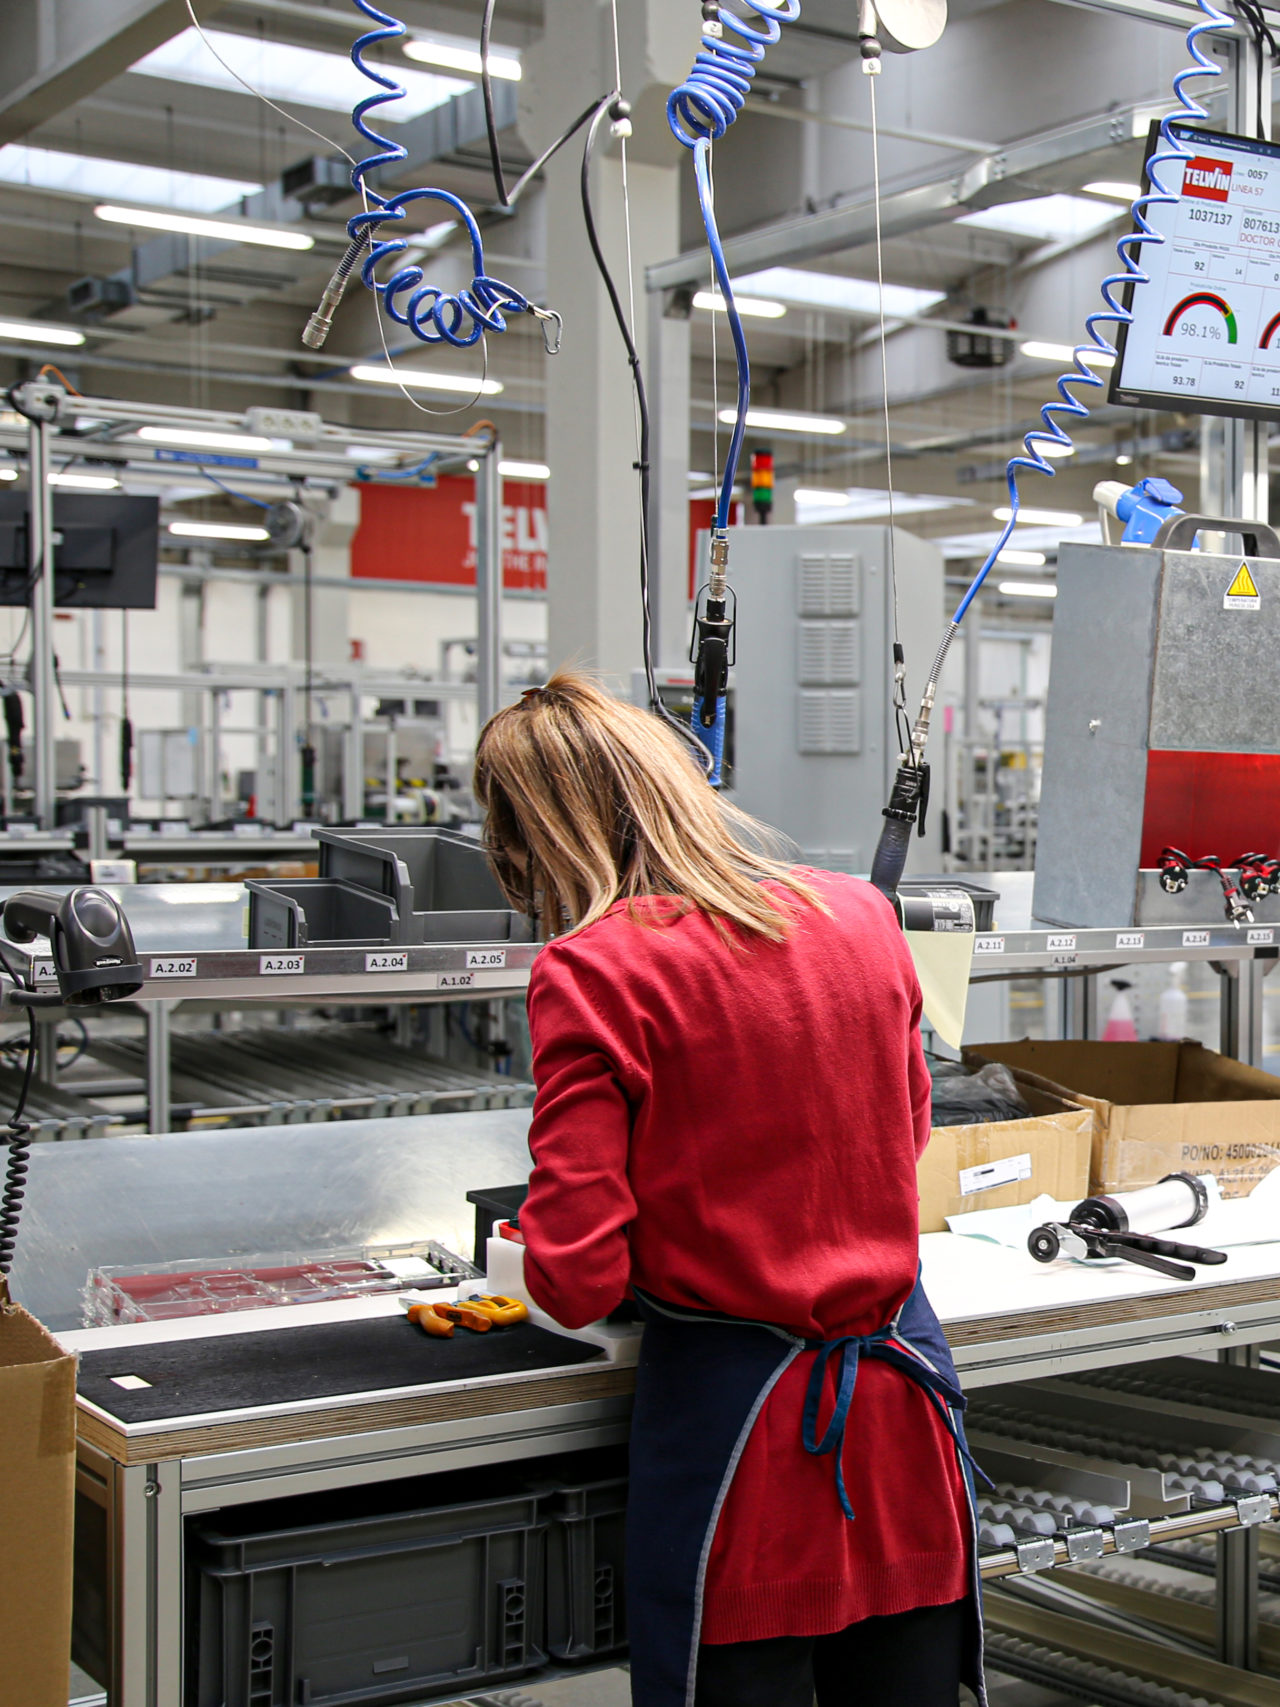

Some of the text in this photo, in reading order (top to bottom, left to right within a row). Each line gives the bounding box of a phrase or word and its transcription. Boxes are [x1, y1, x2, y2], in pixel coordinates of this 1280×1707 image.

[1185, 167, 1231, 191] TELWIN
[1248, 169, 1268, 181] 0057
[1231, 183, 1264, 196] LINEA 57
[1189, 208, 1232, 225] 1037137
[1243, 218, 1280, 233] 807613
[1240, 232, 1275, 247] DOCTOR
[1194, 261, 1205, 271] 92
[1274, 273, 1279, 282] 0
[1180, 322, 1221, 340] 98.1%
[1172, 376, 1196, 387] 93.78
[1234, 380, 1245, 389] 92
[1050, 939, 1073, 947] A.2.12
[1118, 937, 1142, 945] A.2.13
[1185, 935, 1207, 943] A.2.14
[977, 941, 1001, 950] A.2.11
[265, 959, 300, 970] A.2.03
[370, 957, 404, 968] A.2.04
[470, 955, 502, 965] A.2.05
[155, 963, 192, 973] A.2.02
[441, 976, 471, 986] A.1.02
